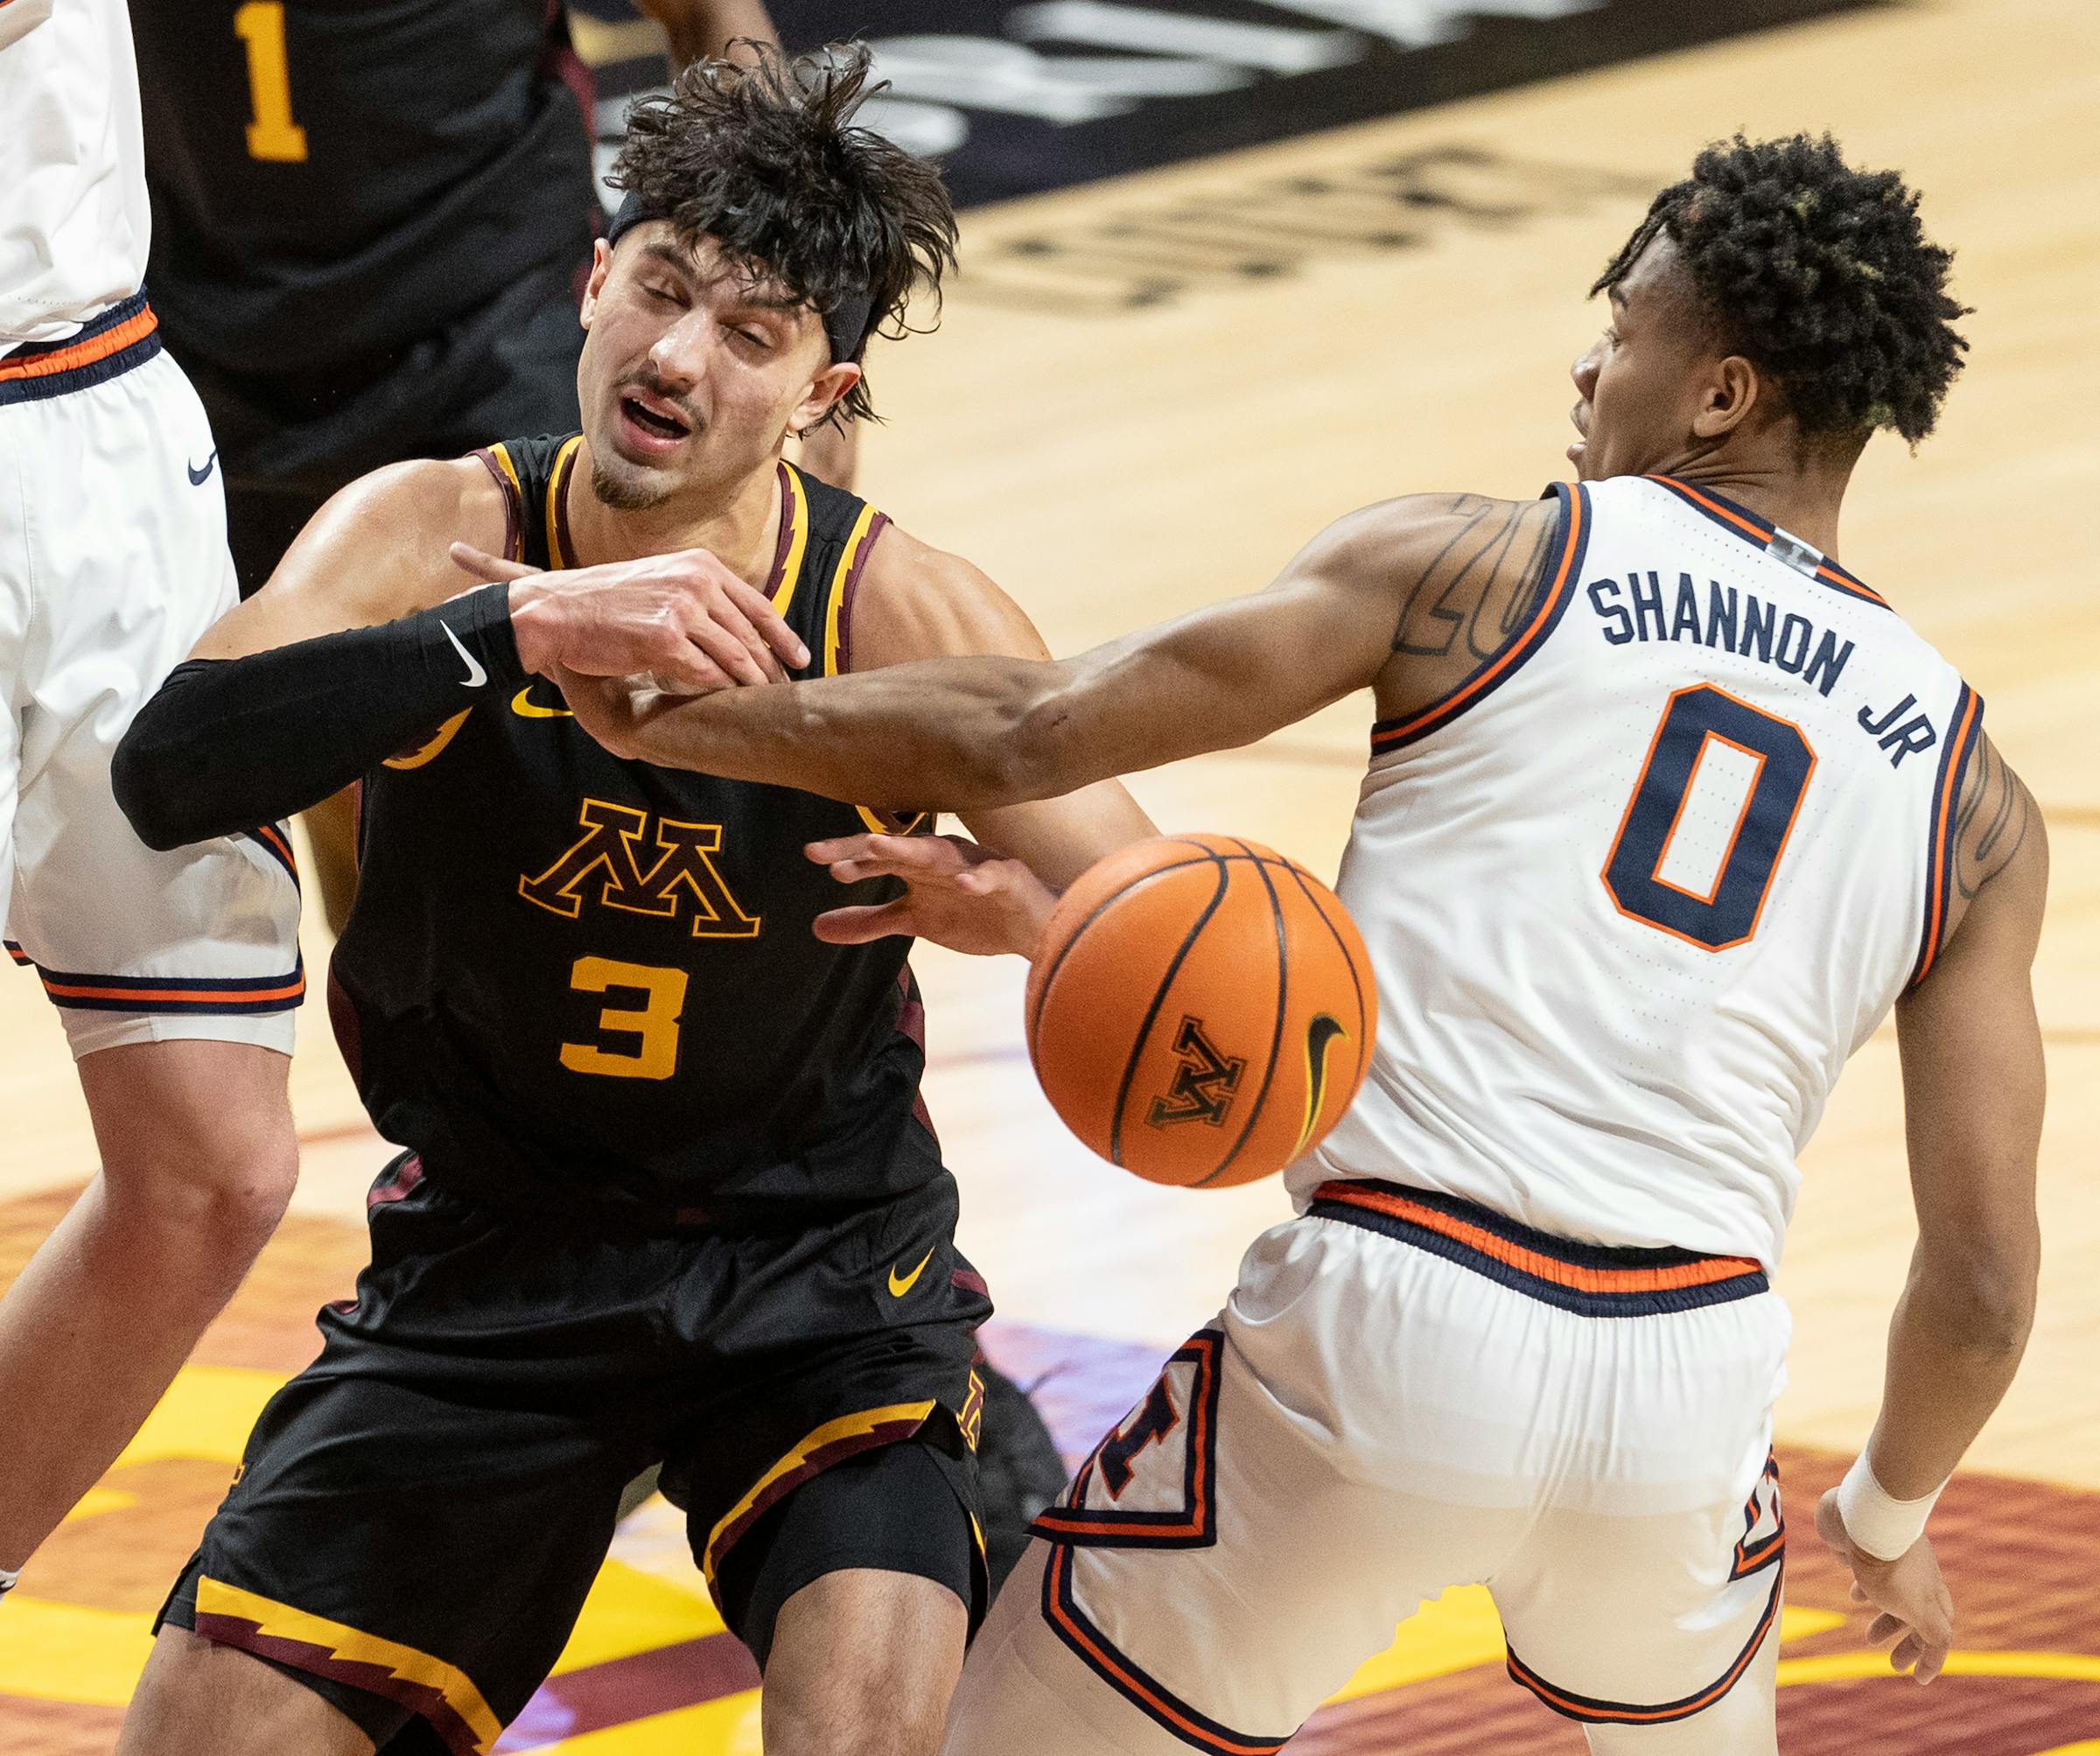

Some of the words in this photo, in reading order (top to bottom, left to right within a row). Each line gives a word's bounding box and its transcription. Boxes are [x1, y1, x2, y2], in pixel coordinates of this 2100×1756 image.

[234, 1, 308, 163] 1
[1586, 571, 1855, 697] SHANNON
[1857, 694, 1936, 769] JR
[518, 797, 761, 938] M
[1600, 682, 1818, 952] 0
[559, 955, 689, 1080] 3
[1144, 1015, 1247, 1130] M
